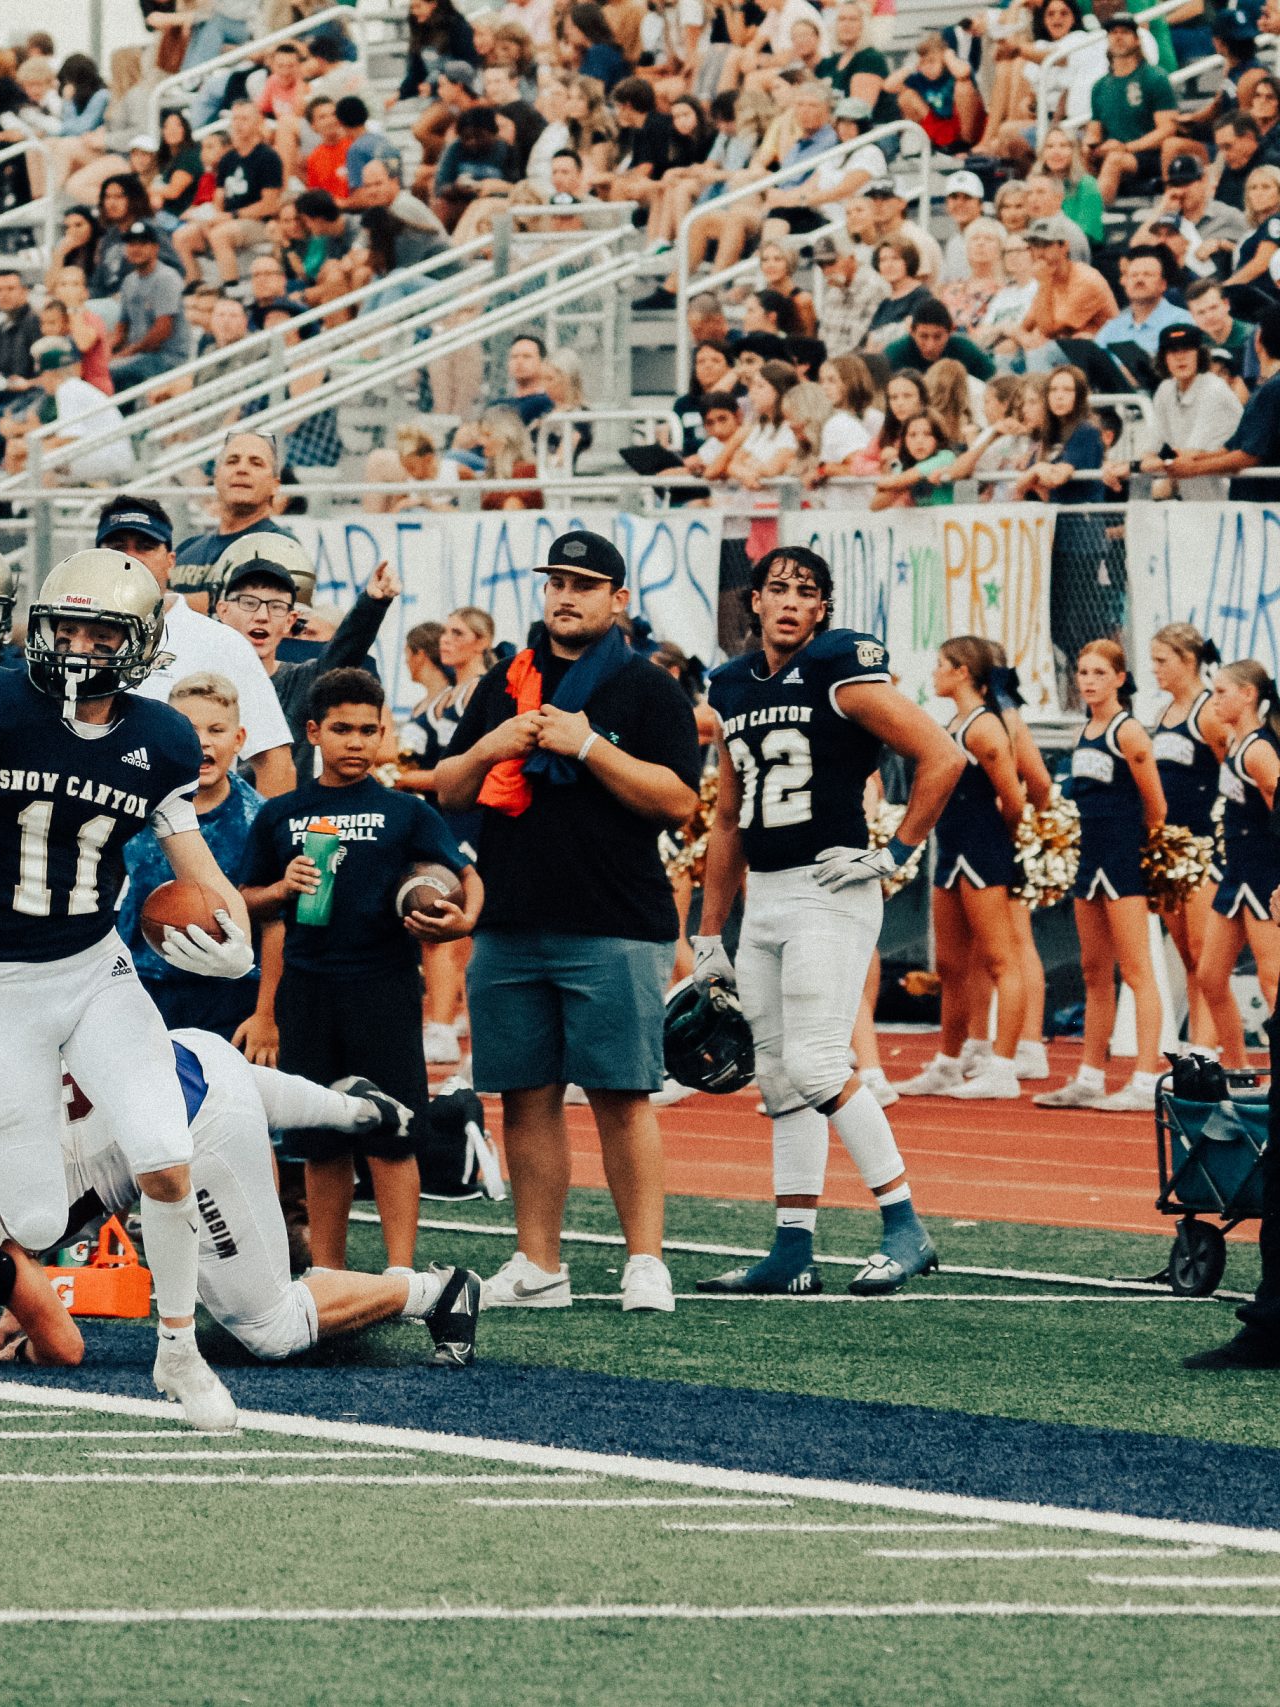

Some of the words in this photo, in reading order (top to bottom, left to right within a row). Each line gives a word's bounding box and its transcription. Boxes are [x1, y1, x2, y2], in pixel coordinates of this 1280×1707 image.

[65, 595, 92, 605] Riddell
[750, 705, 813, 727] CANYON
[121, 754, 151, 771] adidas
[0, 769, 60, 793] SNOW
[65, 776, 149, 818] CANYON
[291, 828, 378, 846] FBALL
[12, 800, 117, 916] 11
[111, 967, 133, 978] adidas
[787, 1272, 812, 1293] IR
